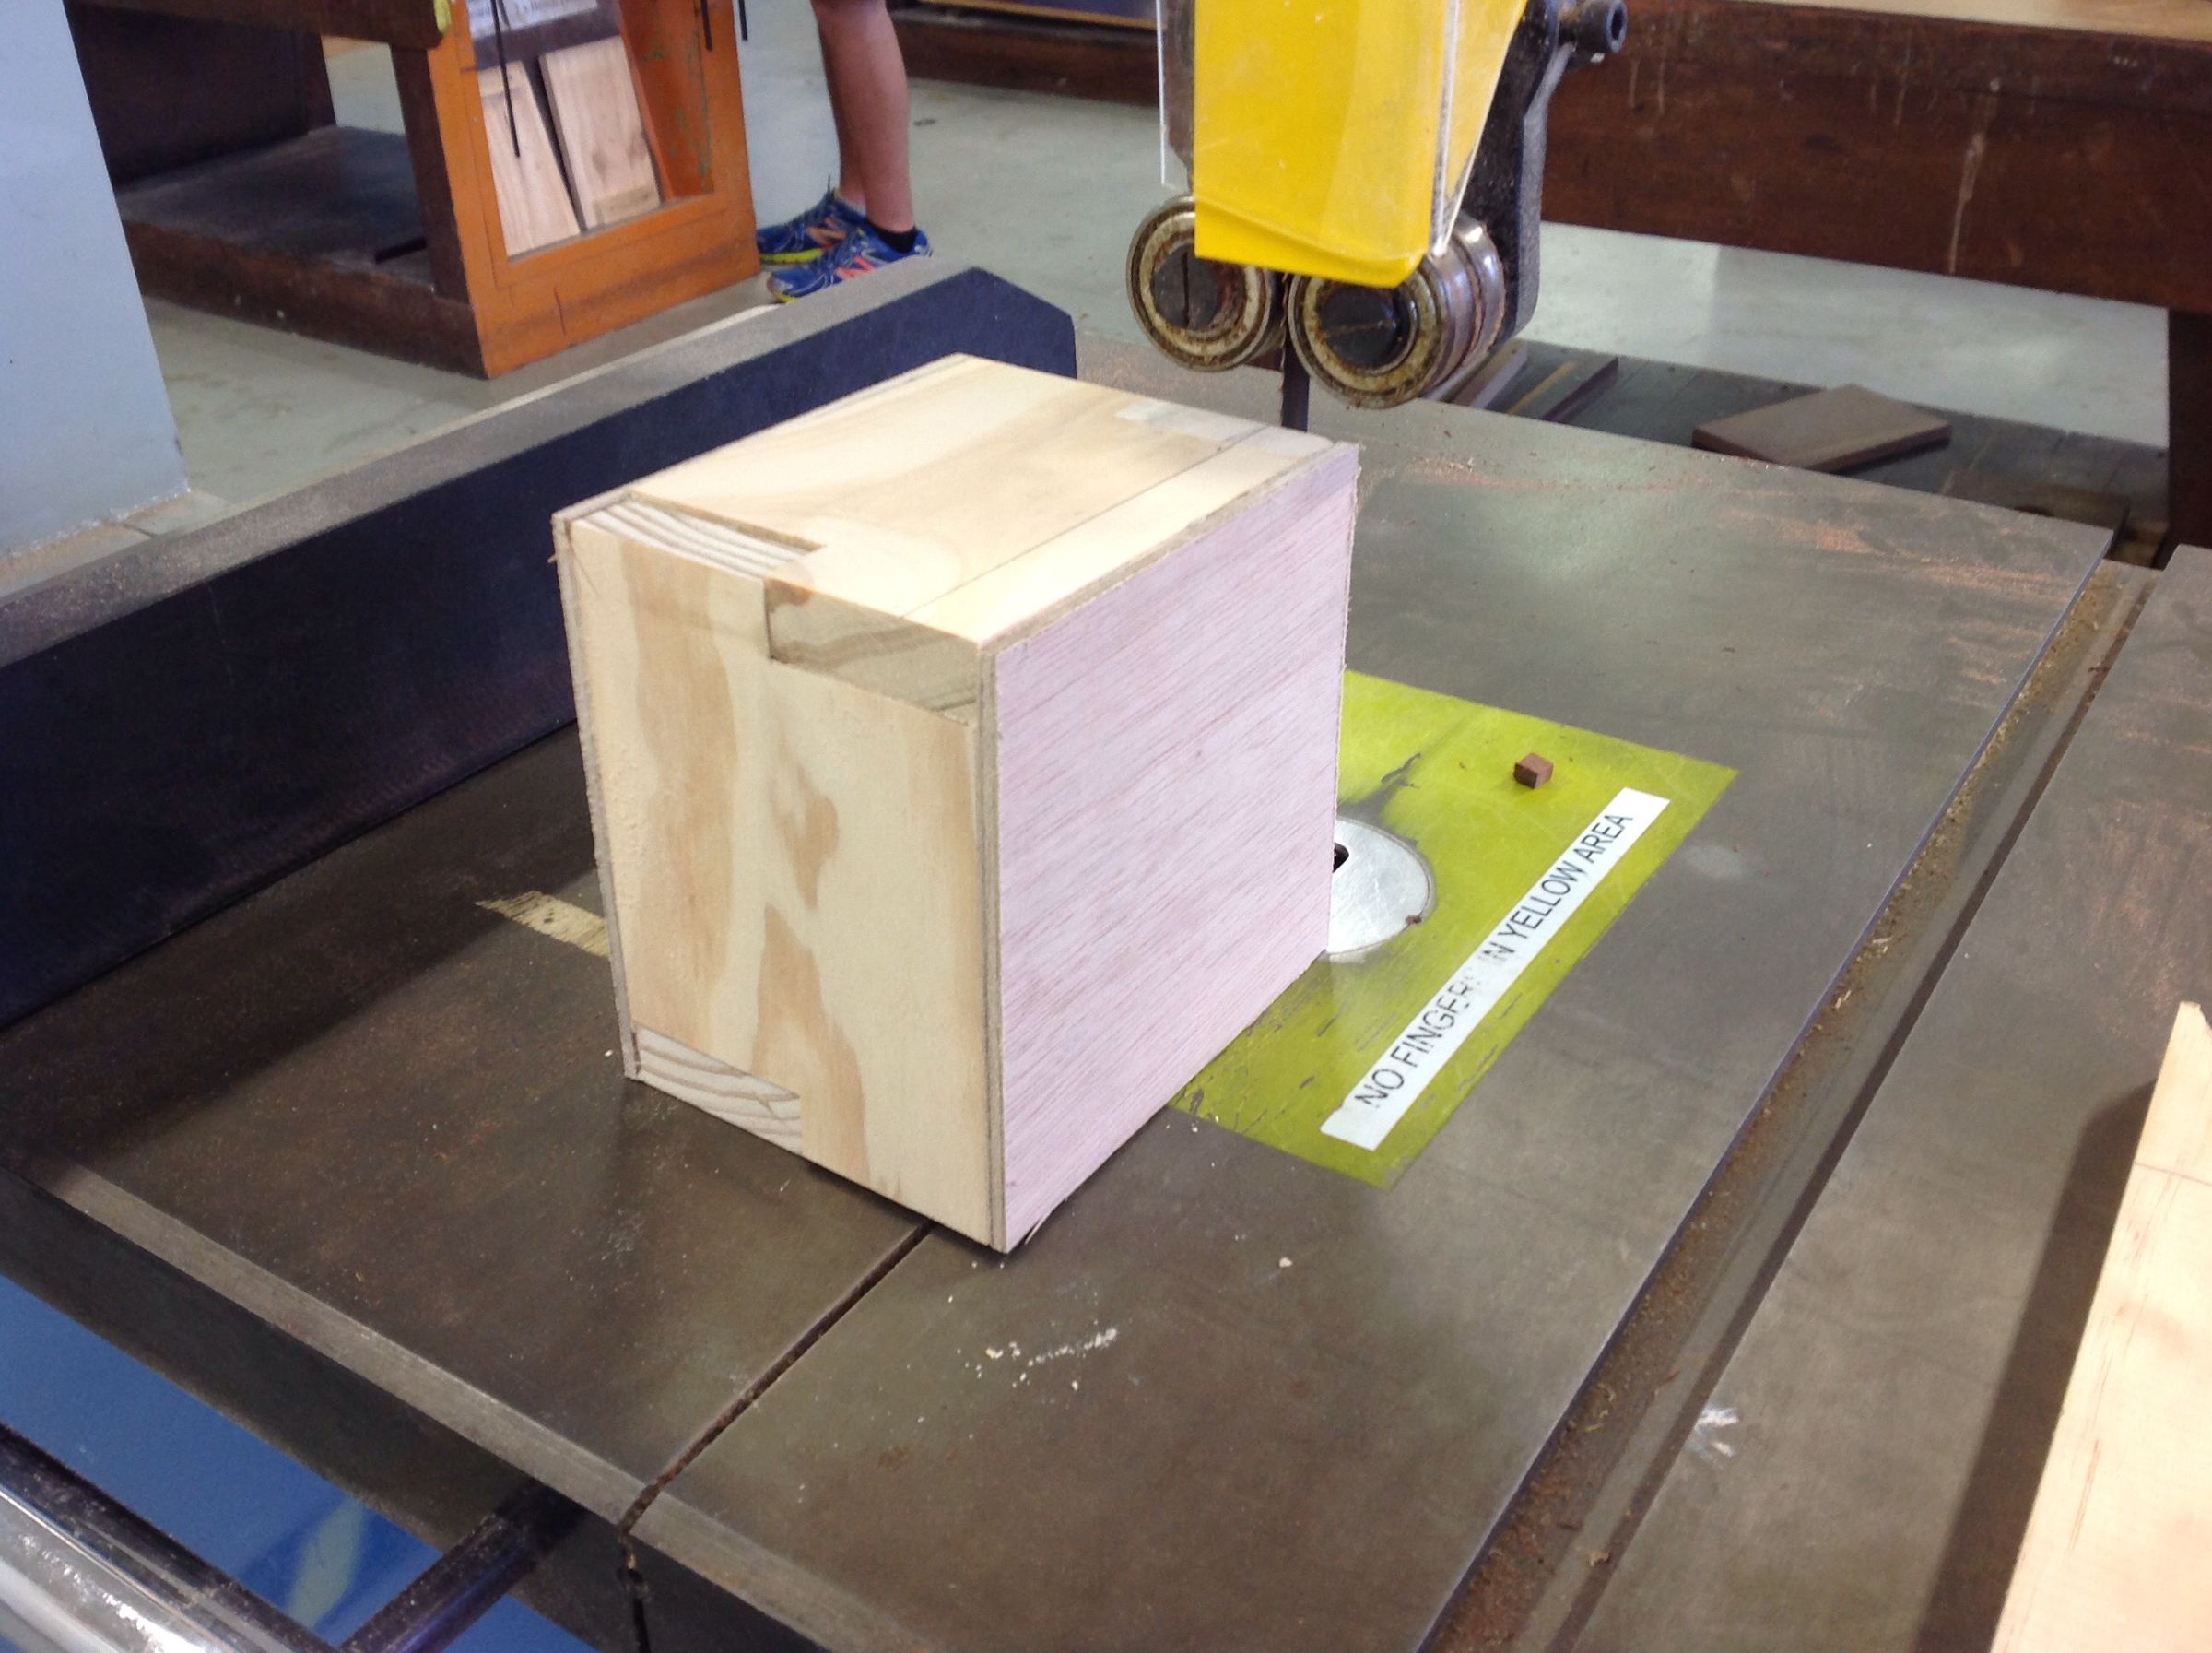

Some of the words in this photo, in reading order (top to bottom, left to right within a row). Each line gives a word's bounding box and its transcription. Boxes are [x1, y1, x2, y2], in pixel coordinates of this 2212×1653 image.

[1354, 1068, 1406, 1109] NO
[1389, 966, 1482, 1069] FINGER
[1477, 941, 1515, 967] N
[1497, 859, 1588, 939] YELLOW
[1572, 813, 1634, 864] AREA
